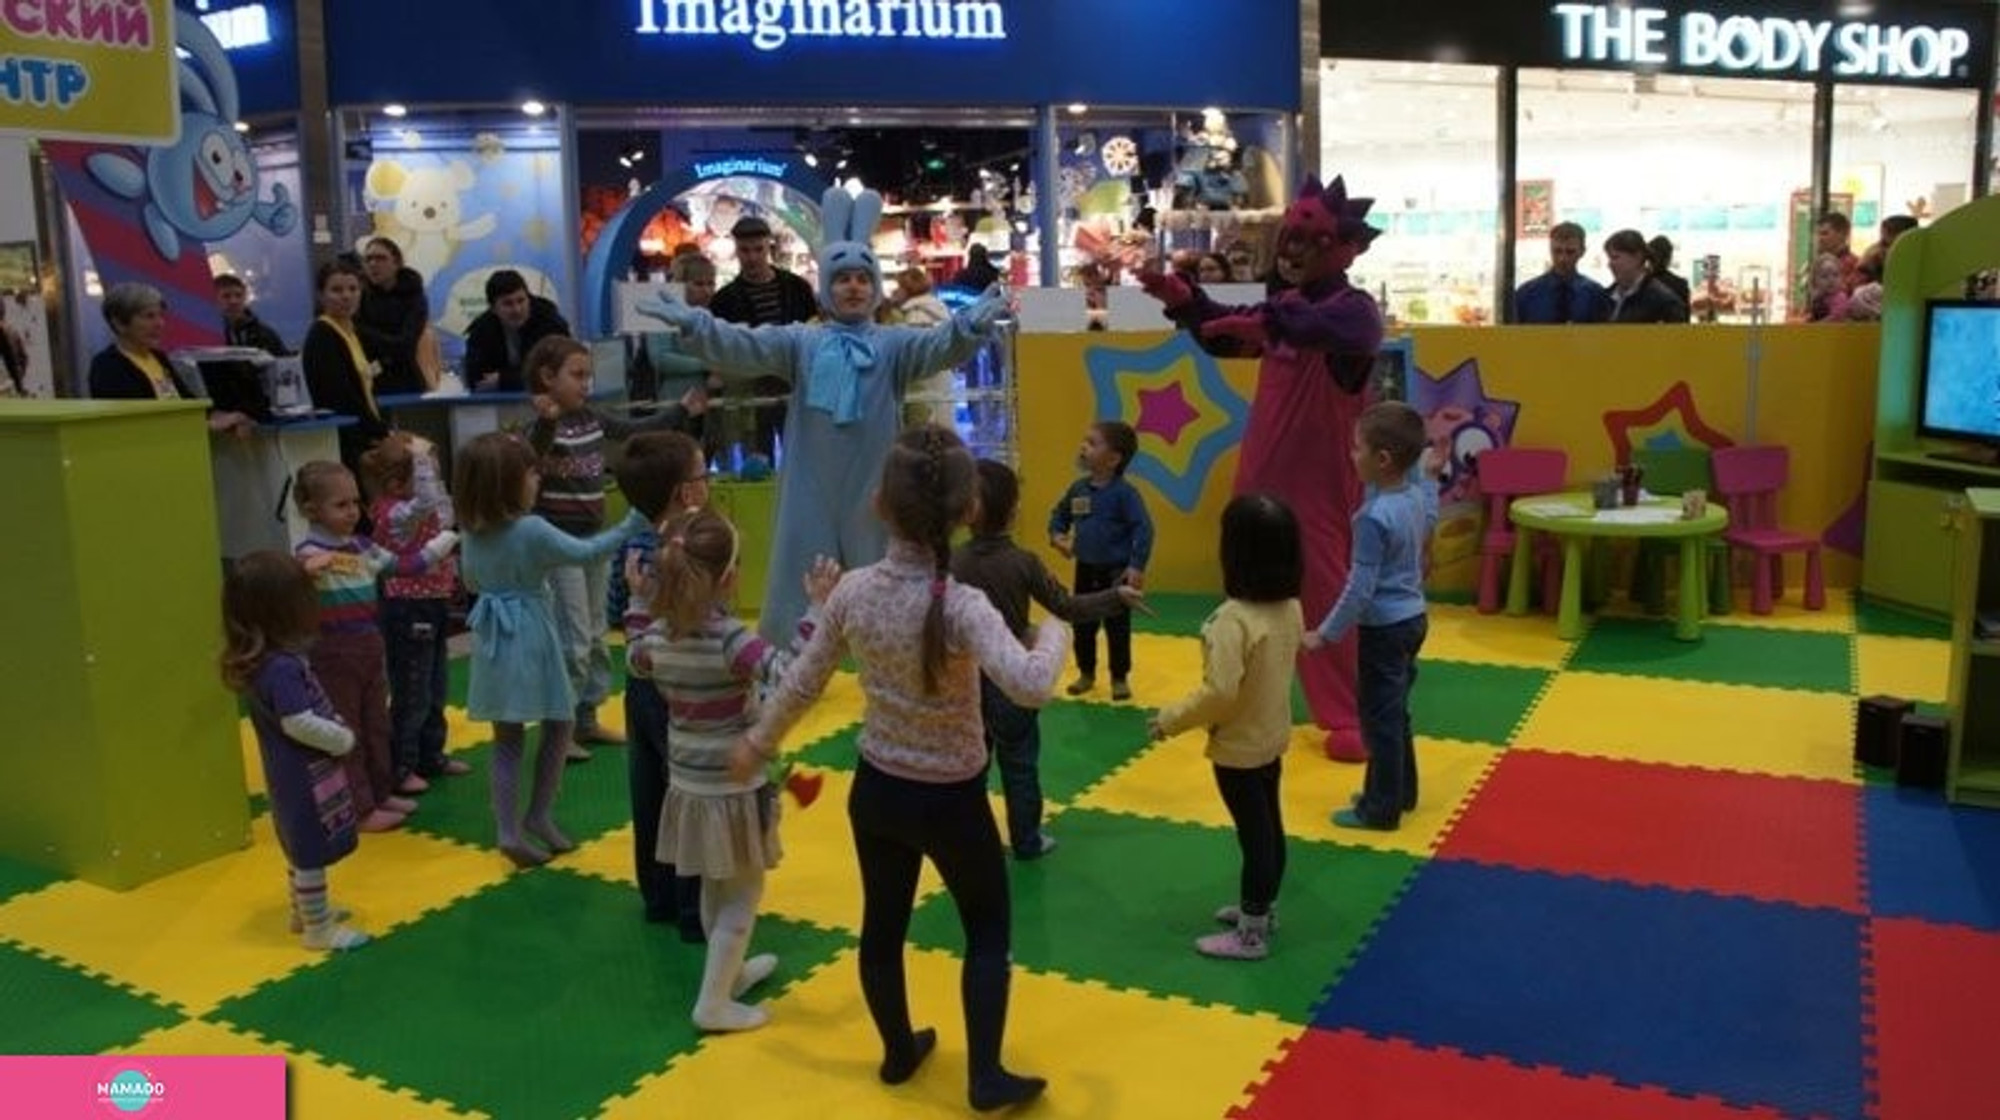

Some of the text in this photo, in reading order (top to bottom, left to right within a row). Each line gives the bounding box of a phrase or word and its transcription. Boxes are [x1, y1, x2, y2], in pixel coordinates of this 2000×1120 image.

[635, 0, 1006, 50] Imaginarium
[1555, 3, 1970, 78] THE BODY SHOP
